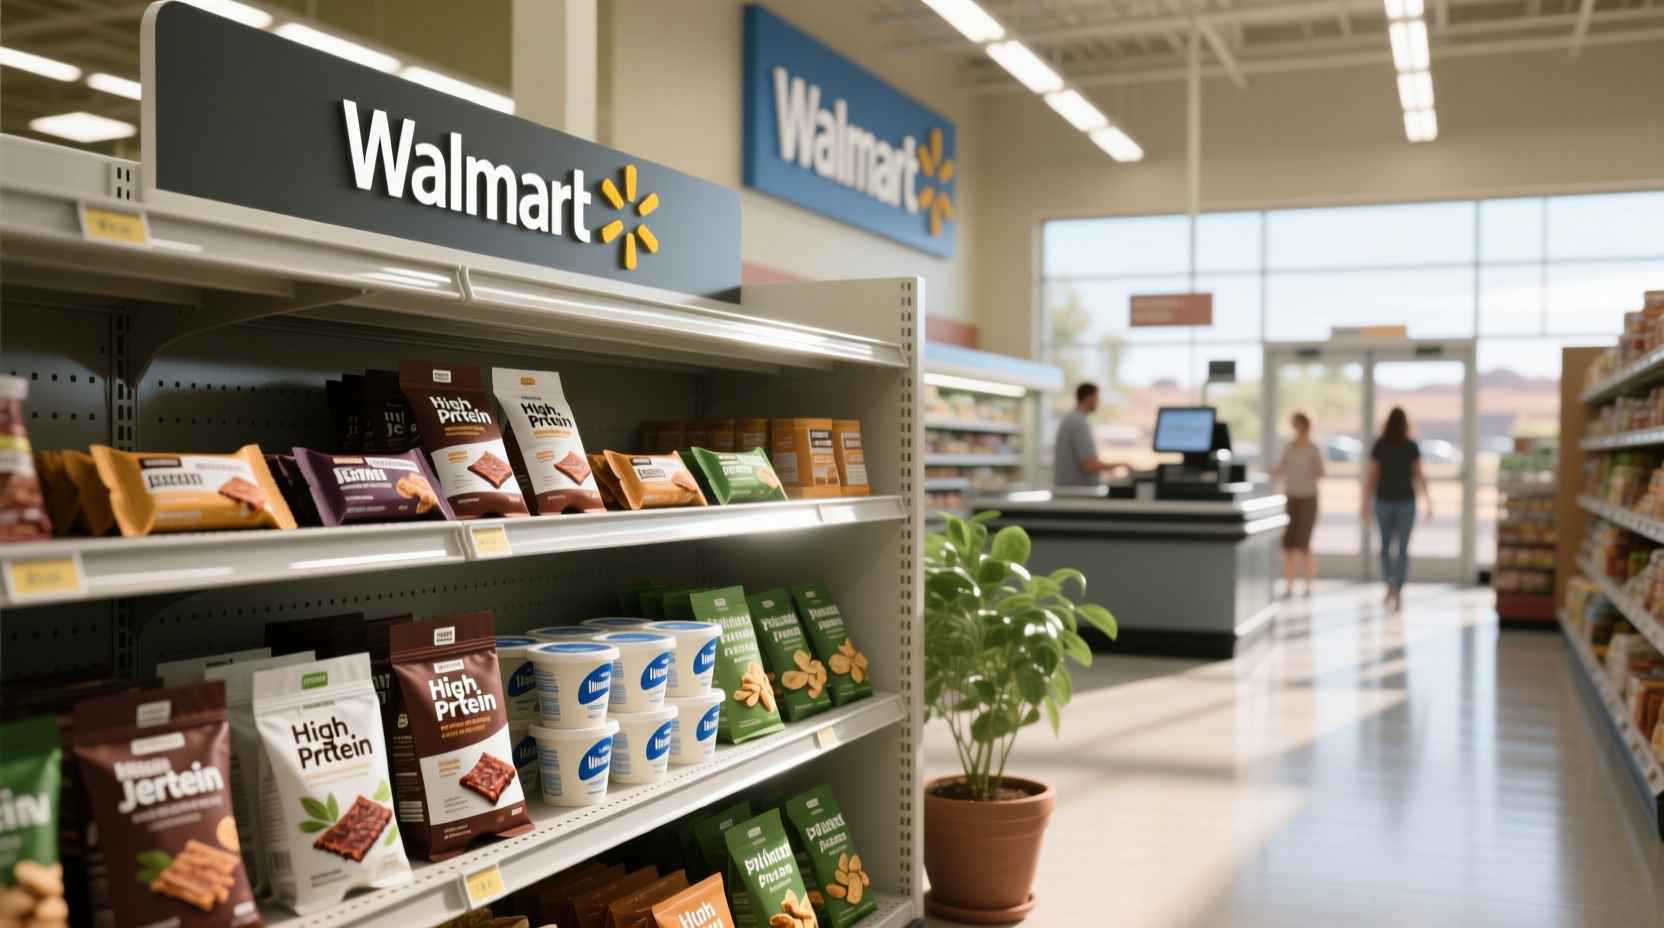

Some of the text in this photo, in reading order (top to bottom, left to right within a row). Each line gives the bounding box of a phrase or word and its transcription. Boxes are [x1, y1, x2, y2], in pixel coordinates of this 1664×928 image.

[773, 66, 919, 215] Walmart
[343, 99, 592, 243] Walmart
[428, 674, 478, 700] High
[291, 716, 349, 748] High
[117, 760, 224, 815] Jertein
